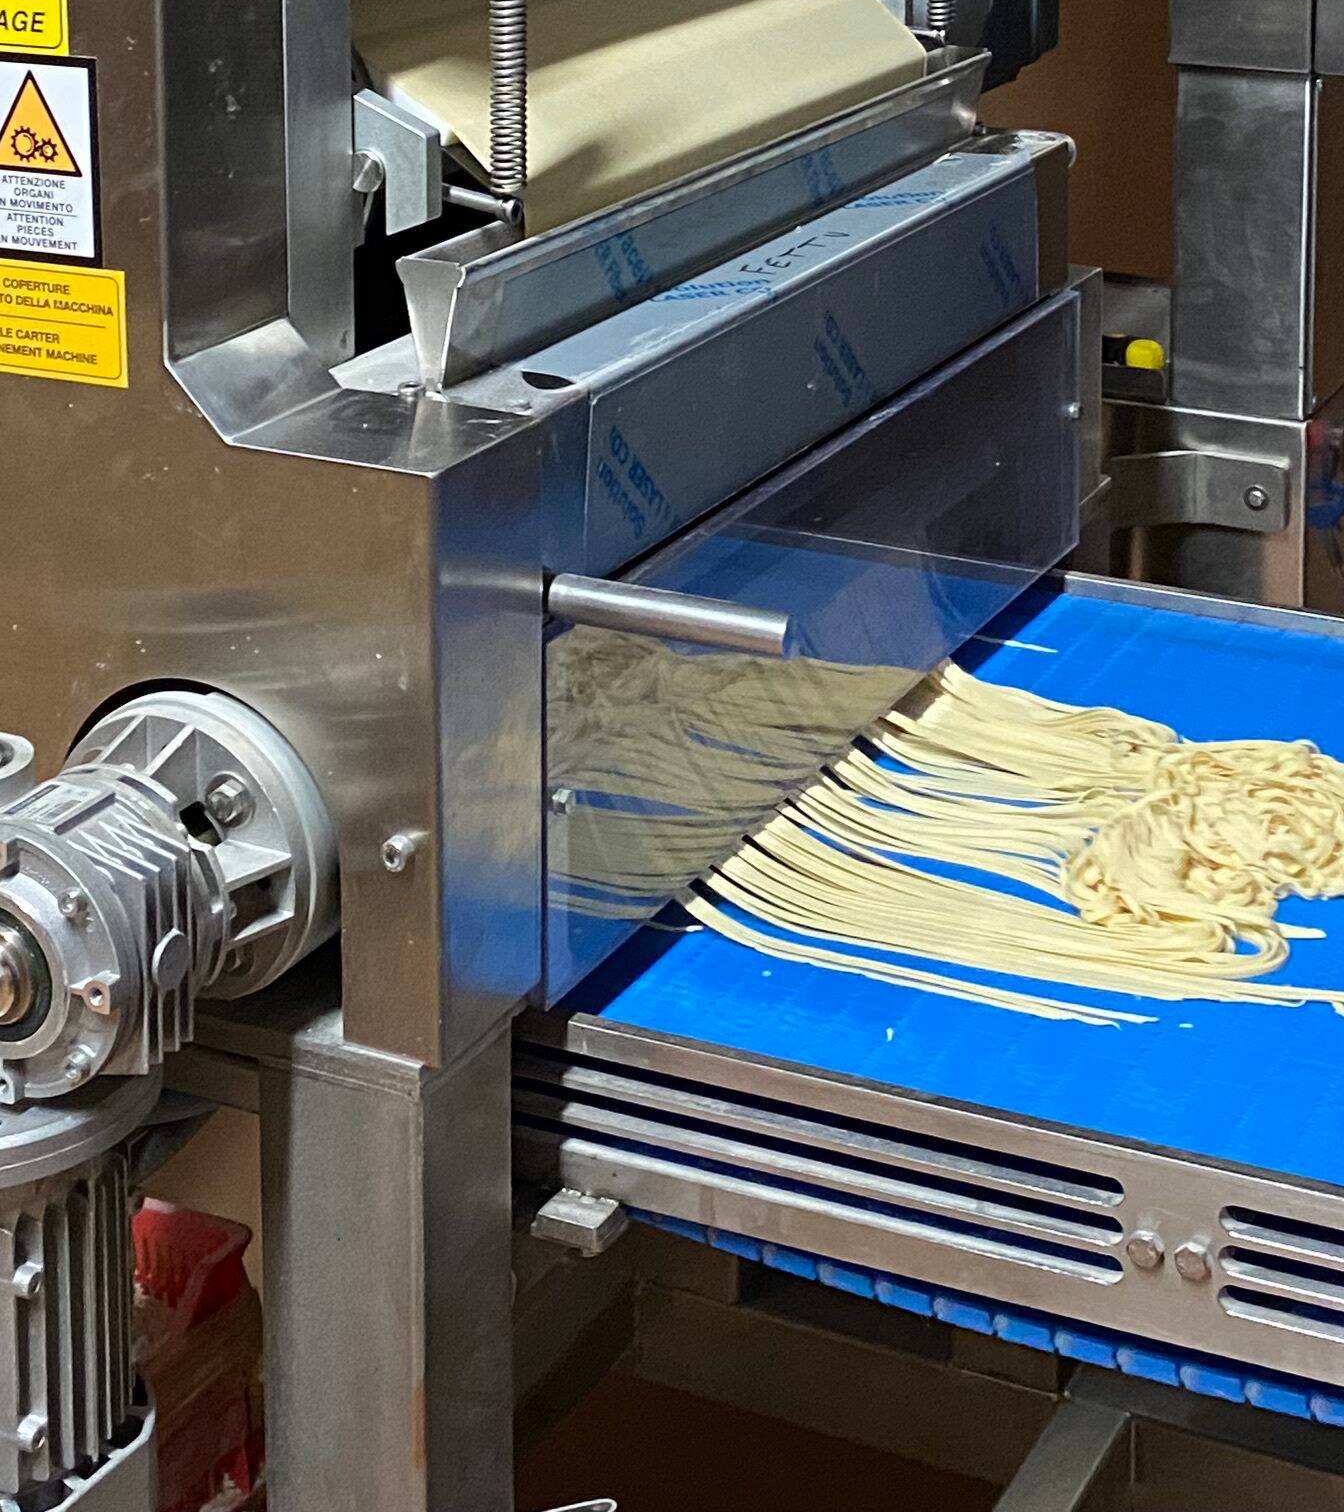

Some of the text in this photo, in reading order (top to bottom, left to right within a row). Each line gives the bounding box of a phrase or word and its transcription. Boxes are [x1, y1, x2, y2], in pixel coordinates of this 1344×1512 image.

[1, 175, 66, 189] ATTENZIONE
[14, 187, 54, 199] ORGANI
[10, 198, 73, 213] MOVIMENTO
[7, 213, 64, 226] ATTENTION
[12, 236, 77, 250] MOUVEMENT
[3, 278, 71, 295] COPERTURE
[16, 295, 51, 309] DELLA
[54, 299, 114, 316] MACCHINA
[0, 328, 13, 338] LE
[16, 329, 60, 344] CARTER
[46, 349, 98, 365] MACHINE
